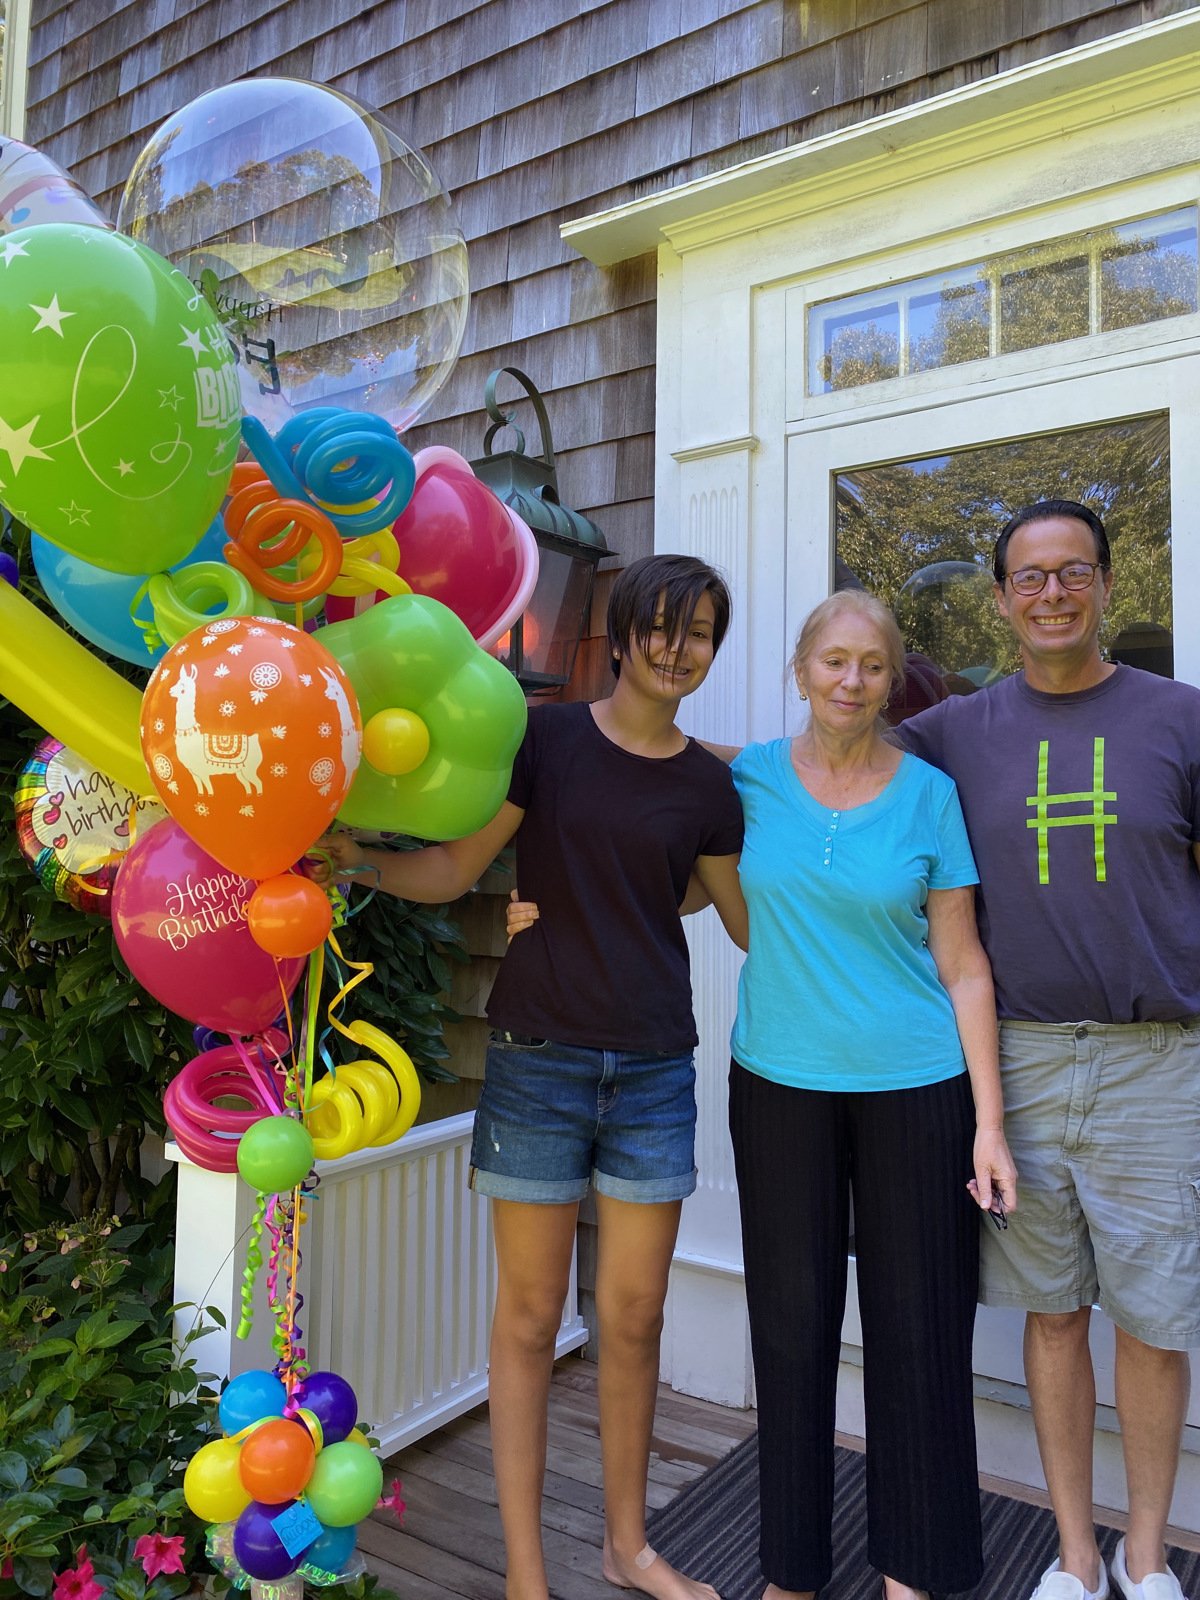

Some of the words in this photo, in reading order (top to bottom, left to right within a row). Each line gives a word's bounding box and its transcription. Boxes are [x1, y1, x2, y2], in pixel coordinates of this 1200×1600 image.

[193, 361, 240, 428] BIR
[65, 788, 160, 836] birthda
[165, 873, 250, 917] Happy
[158, 893, 249, 951] Birthda
